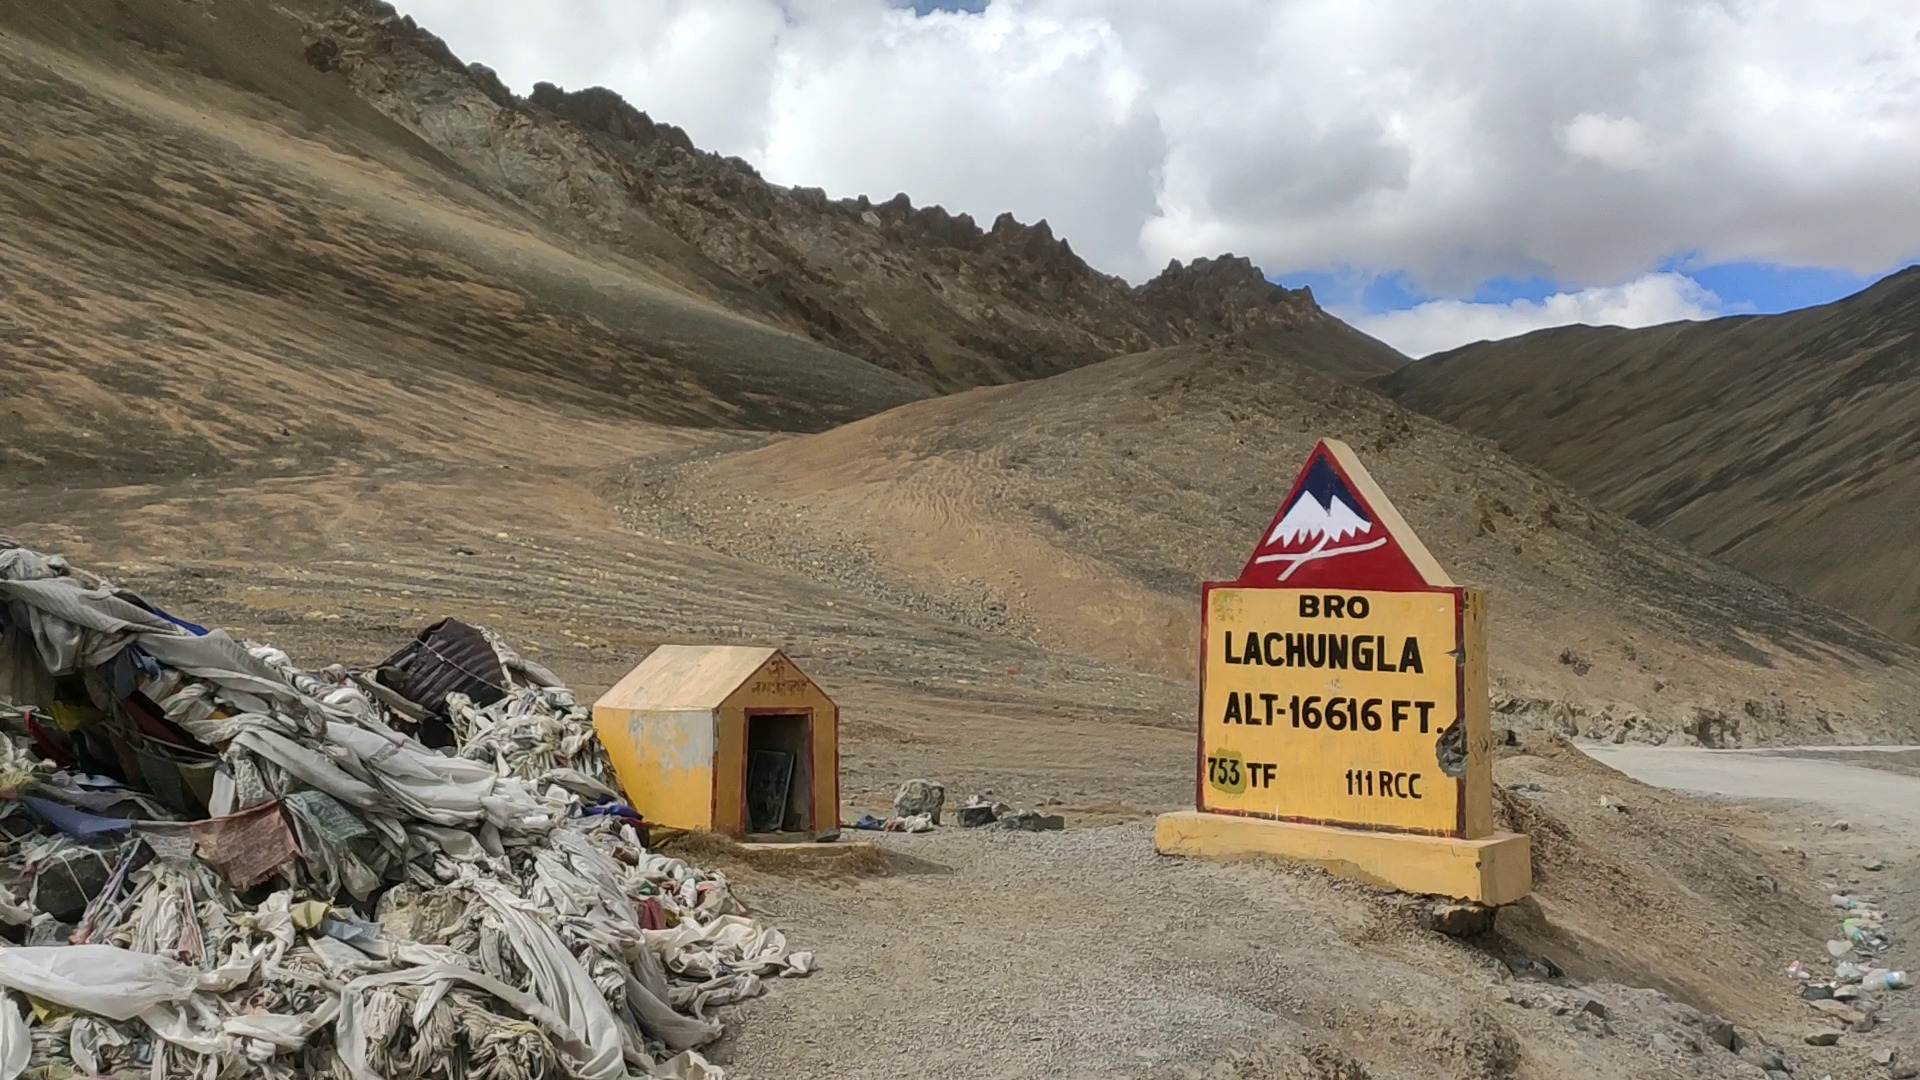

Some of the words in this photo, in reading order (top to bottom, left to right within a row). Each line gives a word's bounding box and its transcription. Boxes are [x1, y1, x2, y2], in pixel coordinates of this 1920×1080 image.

[1299, 594, 1370, 619] BRO
[1225, 630, 1424, 674] LACHUNGLA
[1223, 691, 1383, 732] ALT-16616
[1391, 700, 1445, 735] FT.
[1207, 757, 1240, 786] 753
[1246, 762, 1278, 788] TF
[1379, 770, 1422, 799] RCC
